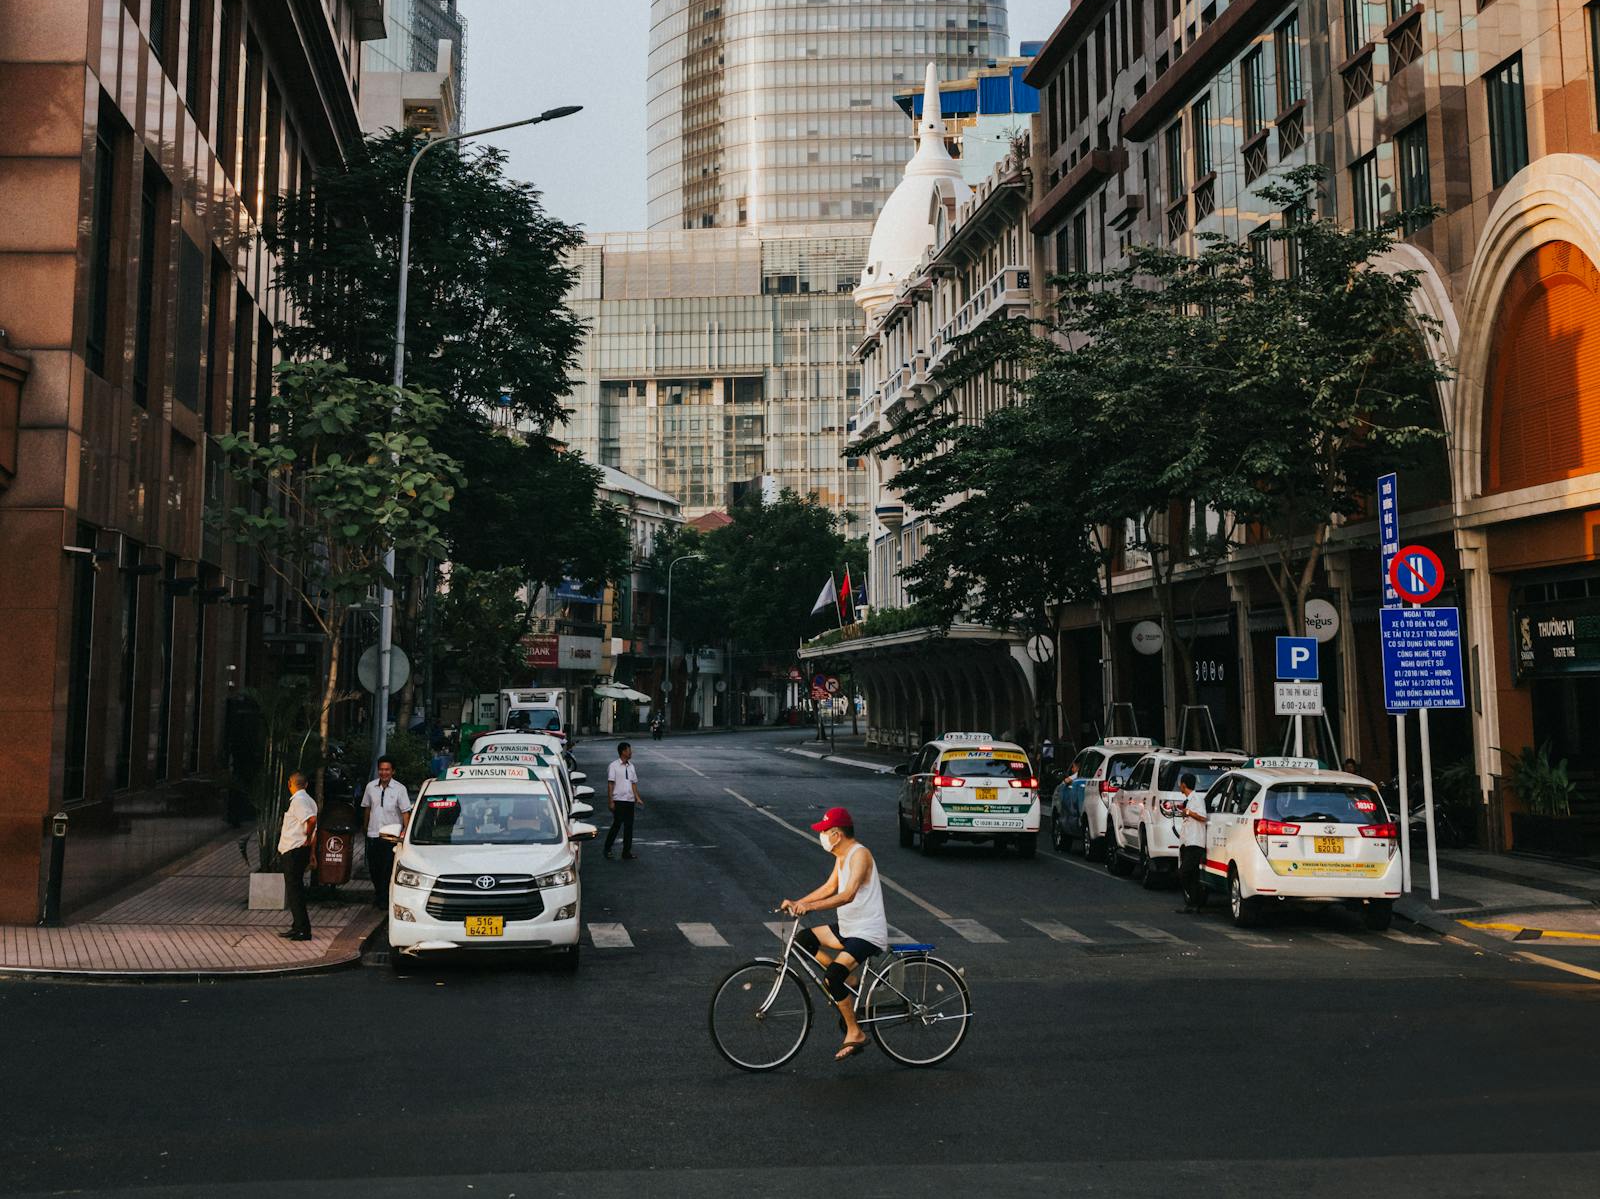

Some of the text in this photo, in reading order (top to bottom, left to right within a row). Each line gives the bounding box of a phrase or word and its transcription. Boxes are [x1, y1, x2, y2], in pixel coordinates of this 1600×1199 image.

[1305, 617, 1333, 629] Regus
[1291, 647, 1310, 670] P
[487, 754, 520, 762] VINASUN
[469, 768, 523, 777] VINASUN TAXI
[983, 805, 990, 813] 2
[1322, 838, 1336, 846] 51G
[476, 917, 493, 926] 51G
[470, 926, 499, 935] 642.11
